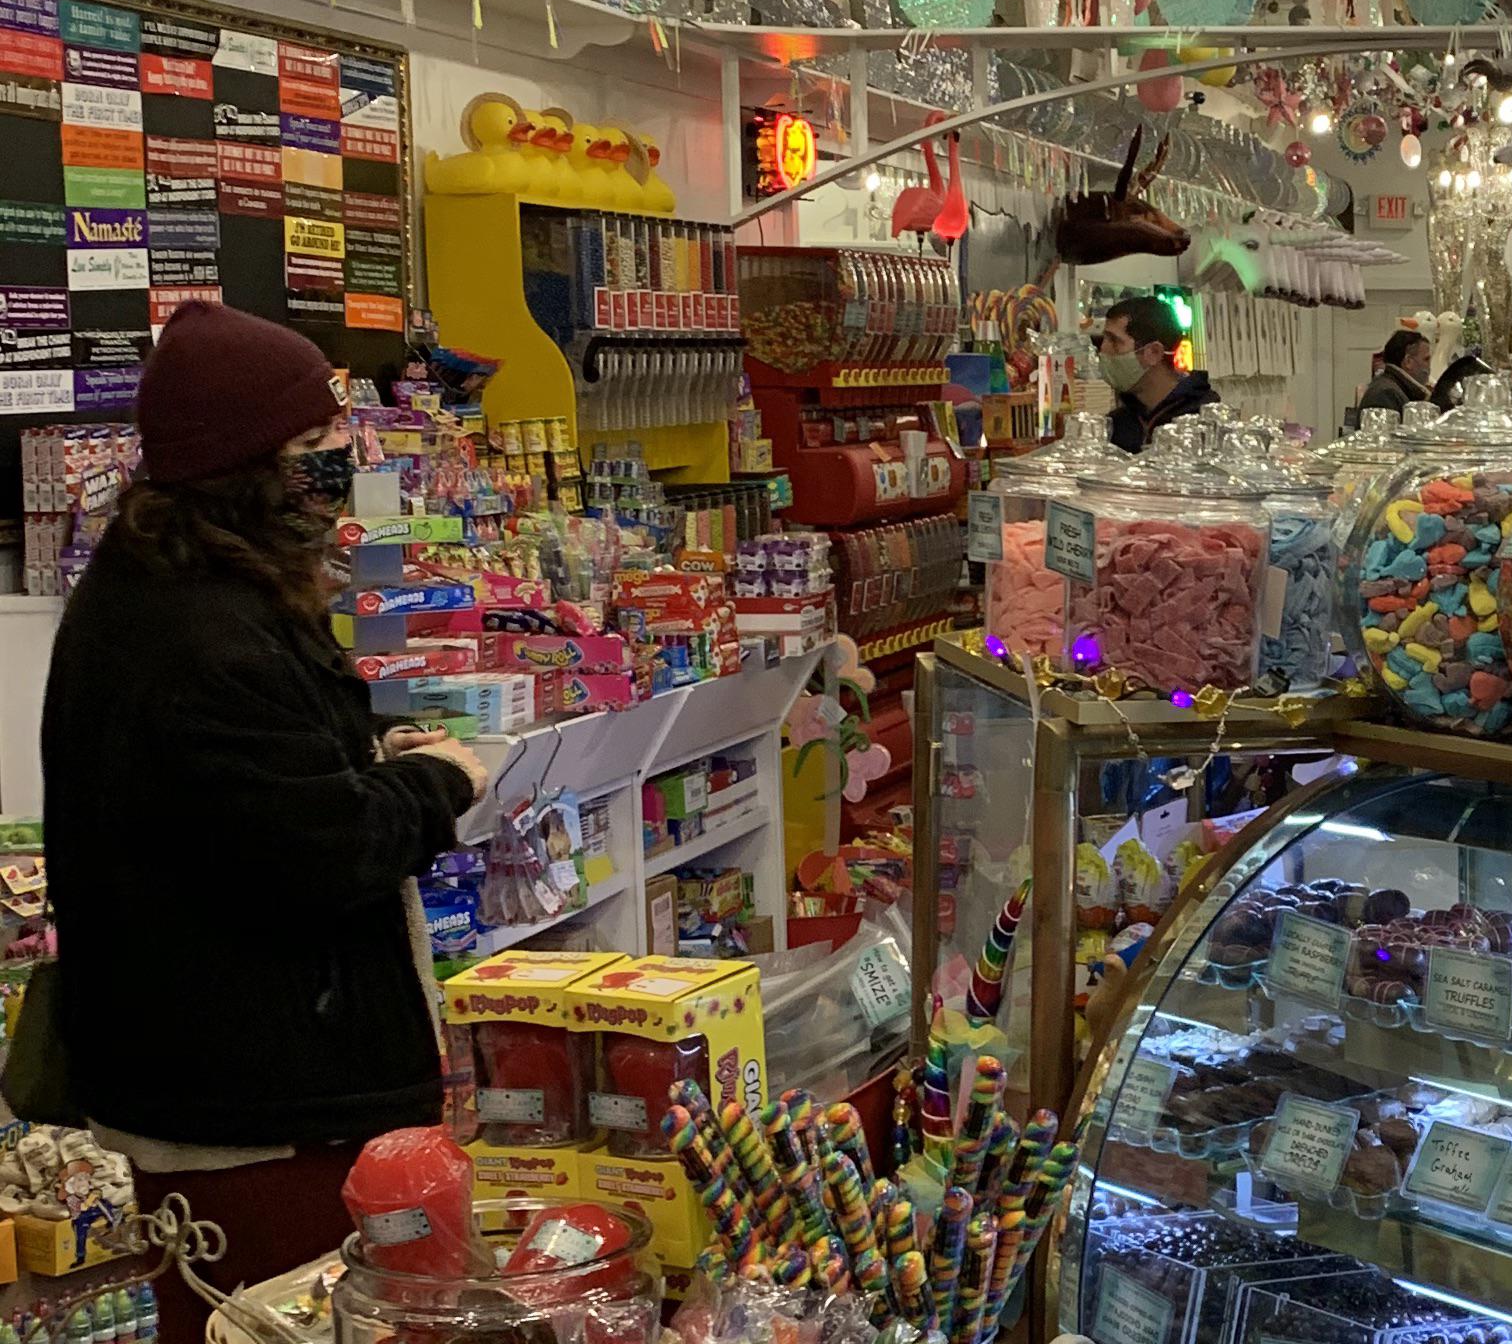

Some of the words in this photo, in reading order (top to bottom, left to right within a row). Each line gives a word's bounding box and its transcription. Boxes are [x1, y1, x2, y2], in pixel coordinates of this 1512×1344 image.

[1377, 196, 1406, 219] EXIT
[72, 211, 142, 242] Namasté
[680, 559, 715, 572] COW
[1434, 973, 1448, 984] SEA
[1451, 975, 1471, 988] SALT
[1444, 988, 1495, 1011] TRUFFLES
[1431, 1138, 1471, 1162] Toffee
